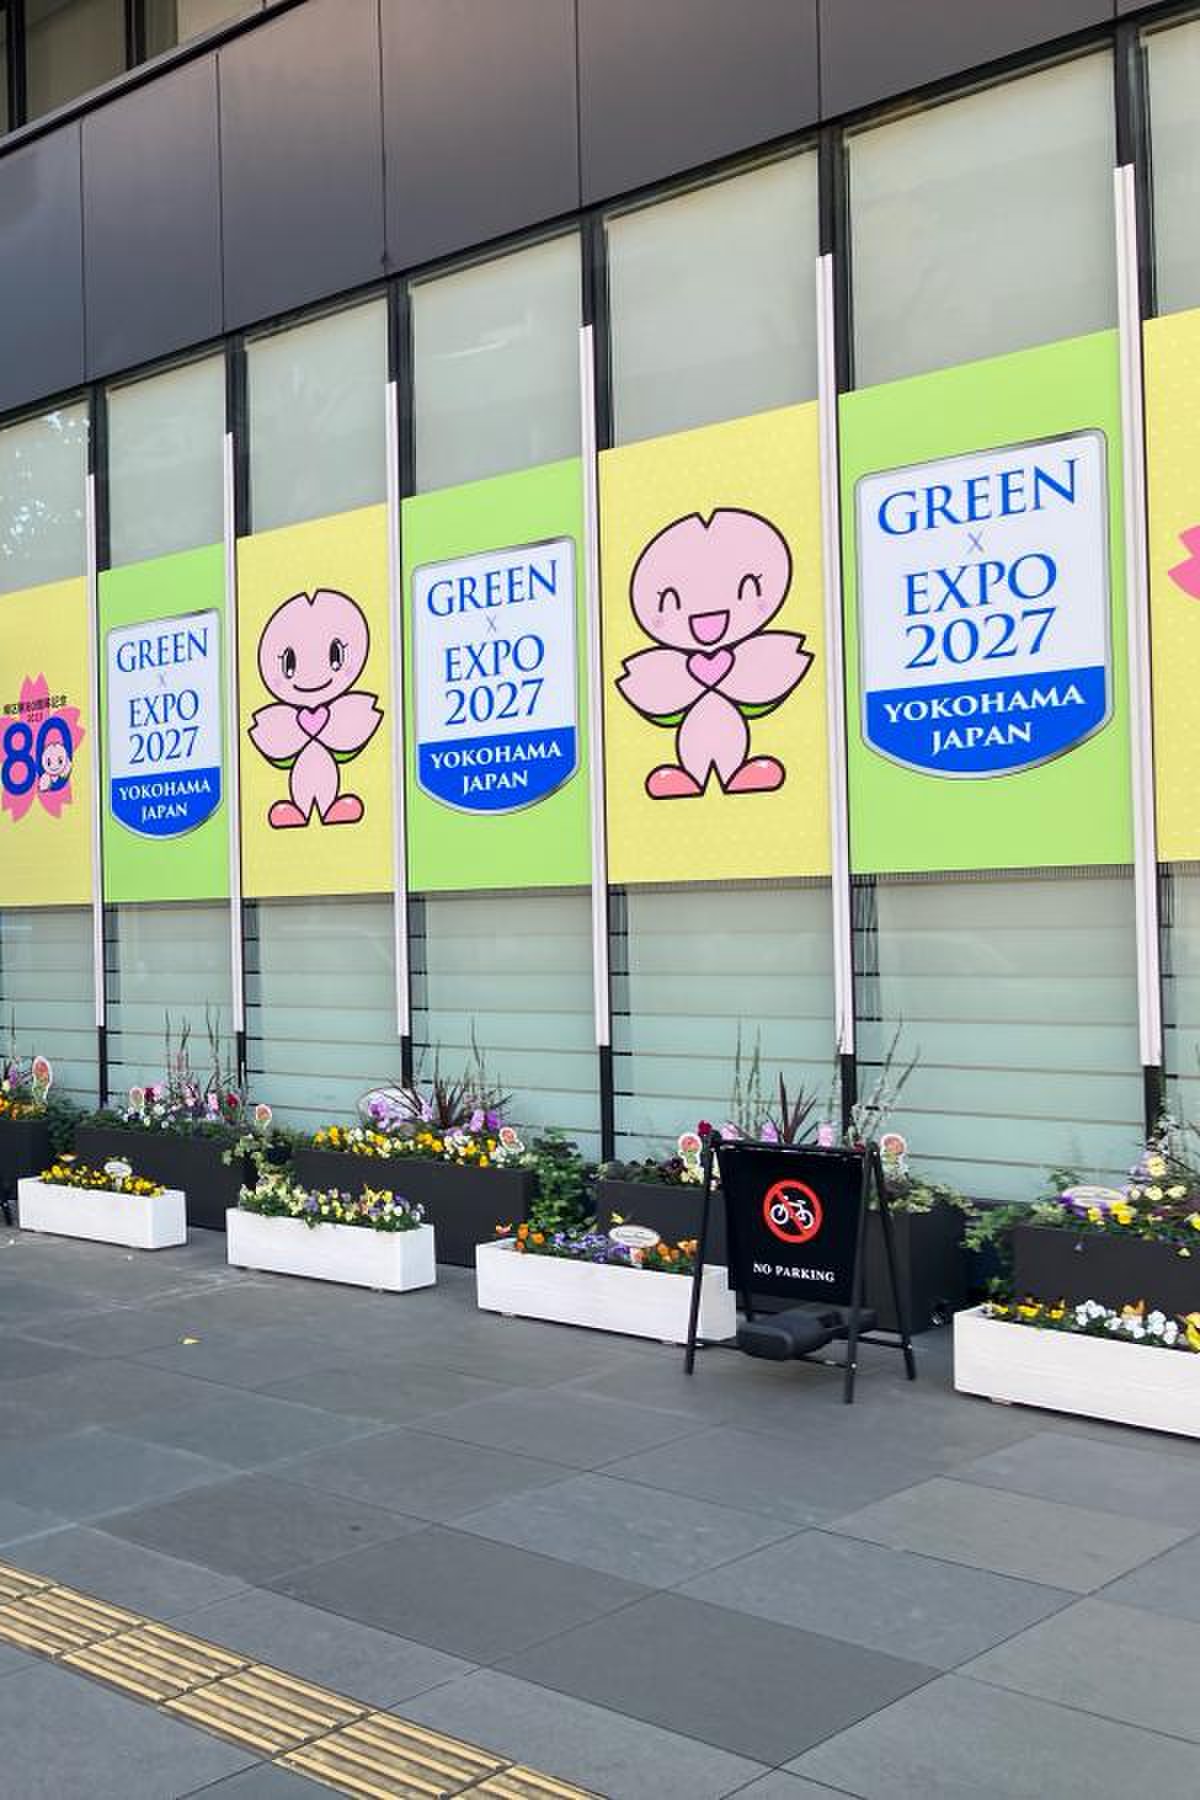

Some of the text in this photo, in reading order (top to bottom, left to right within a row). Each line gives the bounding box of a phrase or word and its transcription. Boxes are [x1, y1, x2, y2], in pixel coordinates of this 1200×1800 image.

[877, 458, 1080, 536] GREEN
[427, 560, 557, 617] GREEN
[905, 553, 1057, 616] EXPO
[116, 627, 209, 672] GREEN
[905, 607, 1057, 669] 2027
[445, 634, 545, 683] EXPO
[129, 689, 199, 728] EXPO
[445, 678, 544, 726] 2027
[884, 684, 1086, 723] YOKOHAMA
[1, 716, 73, 796] 80
[129, 726, 200, 765] 2027
[431, 740, 562, 769] YOKOHAMA
[932, 722, 1031, 756] JAPAN
[118, 777, 211, 801] YOKOHAMA
[462, 770, 529, 796] JAPAN
[141, 803, 188, 823] JAPAN
[753, 1263, 836, 1283] NO PARKING
